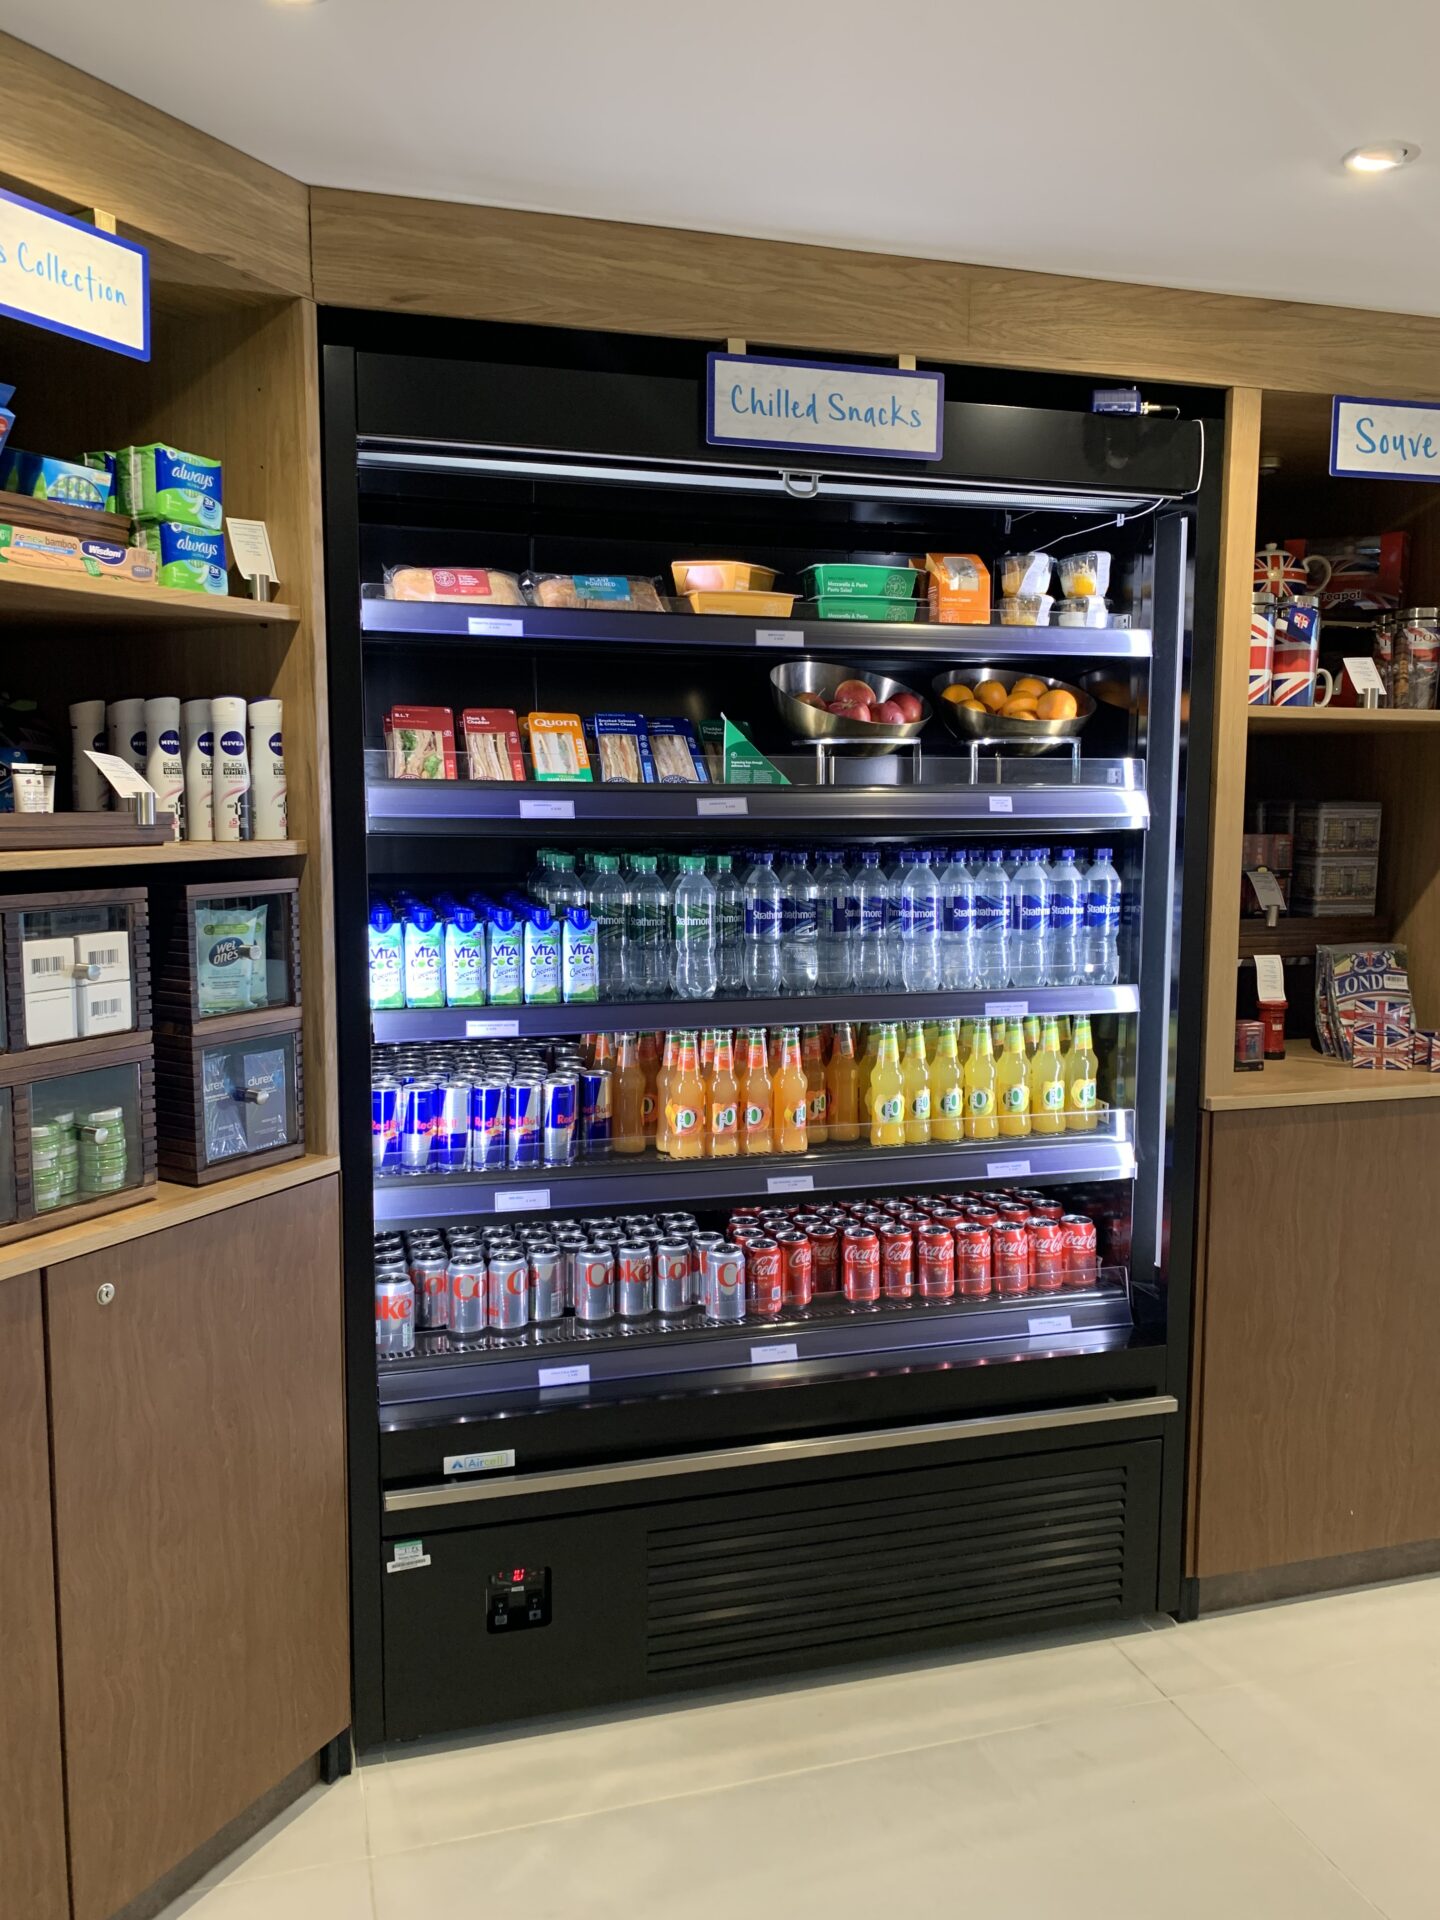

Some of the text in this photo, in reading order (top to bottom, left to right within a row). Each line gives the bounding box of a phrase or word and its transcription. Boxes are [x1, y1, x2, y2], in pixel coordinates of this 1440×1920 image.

[17, 241, 128, 306] Collection
[730, 384, 922, 428] Chilled Snacks
[1355, 417, 1438, 461] Souve
[171, 463, 214, 490] always
[45, 536, 78, 550] bamboo
[176, 535, 218, 560] always
[88, 544, 122, 558] Wisdom
[1319, 590, 1361, 602] Teapot
[534, 718, 578, 727] Quorn
[216, 940, 236, 954] wet
[371, 947, 398, 959] VITA
[415, 946, 439, 958] VITA
[454, 946, 479, 958] VITA
[493, 944, 518, 956] VITA
[531, 944, 556, 956] VITA
[570, 943, 594, 955] VITA
[213, 949, 239, 964] ones
[1334, 974, 1383, 996] LOND
[247, 1073, 274, 1087] durex
[468, 1455, 504, 1469] Aircell
